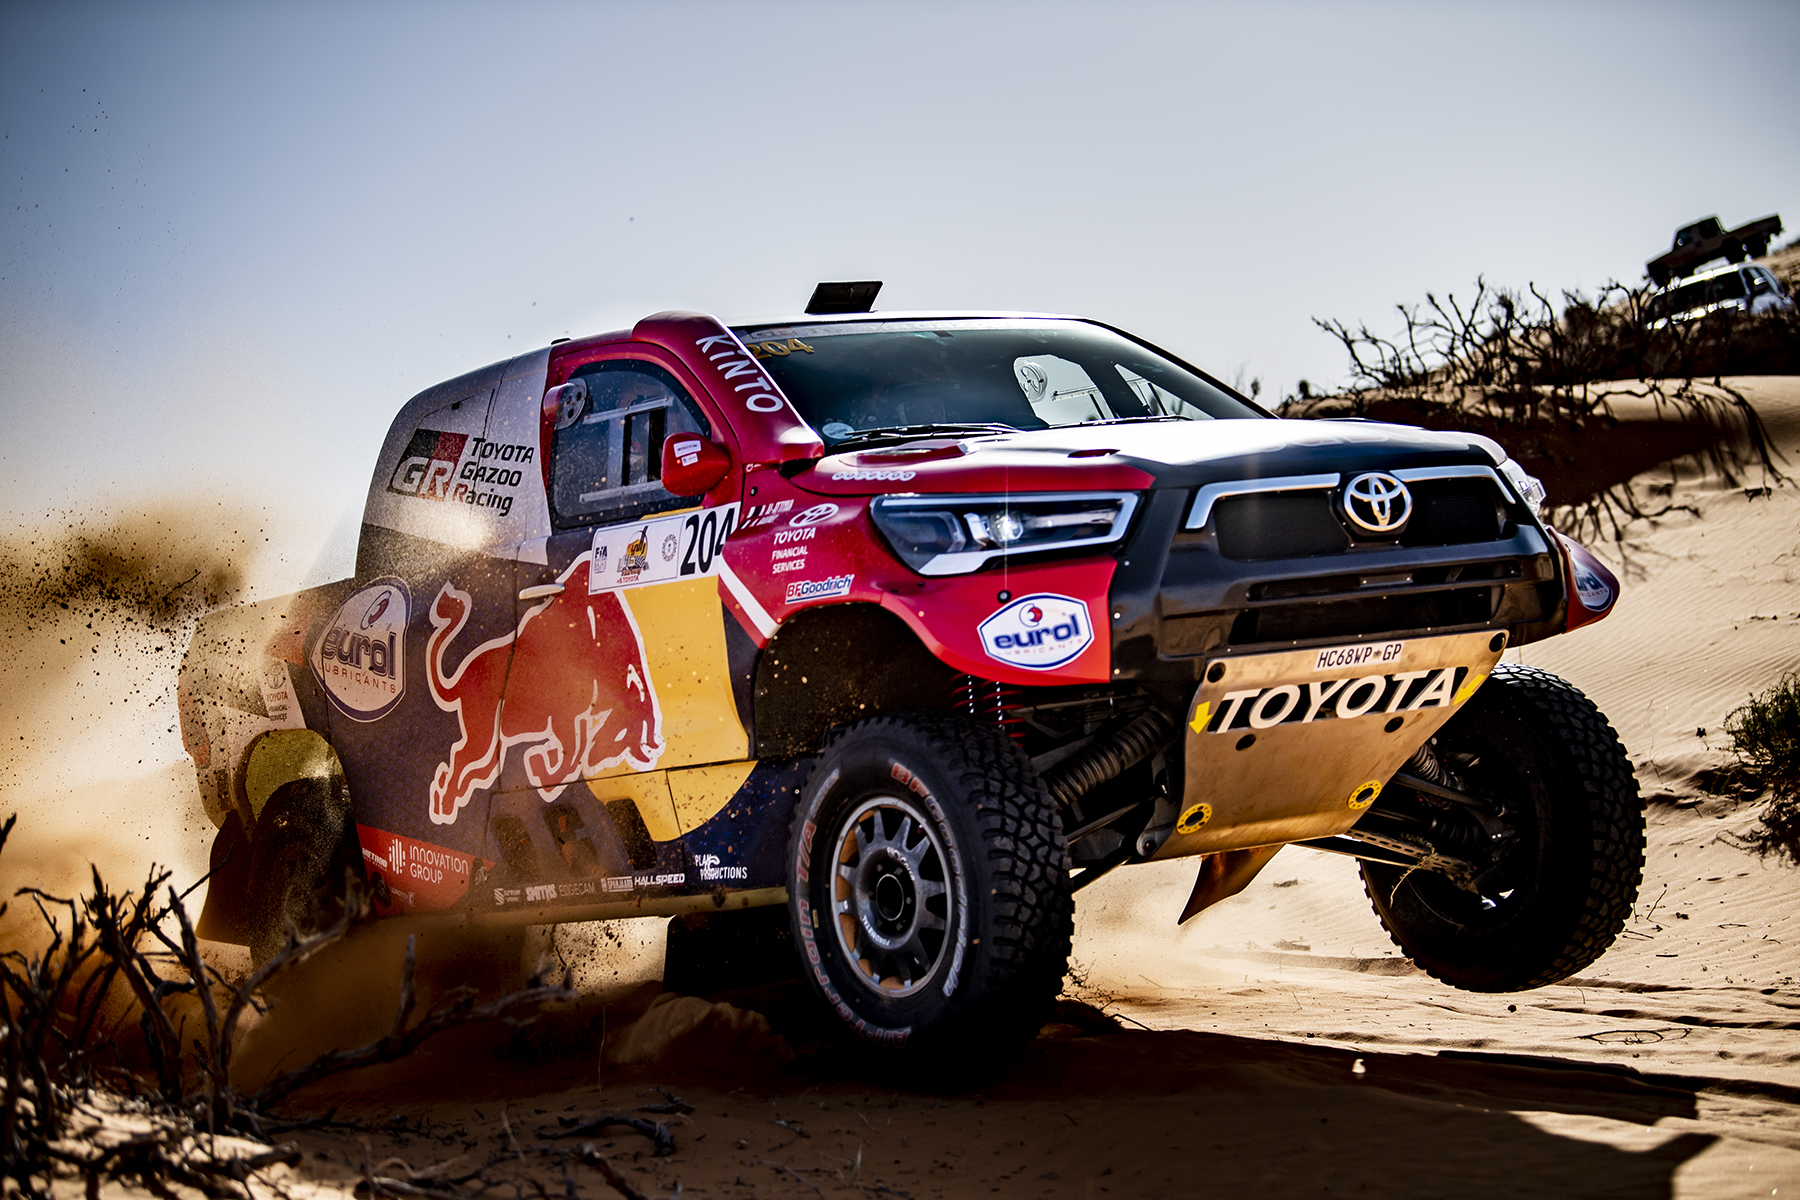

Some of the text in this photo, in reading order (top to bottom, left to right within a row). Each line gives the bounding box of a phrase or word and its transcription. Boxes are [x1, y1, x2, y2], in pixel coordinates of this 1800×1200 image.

[471, 437, 535, 464] TOYOTA
[391, 456, 456, 499] GR
[460, 461, 523, 487] GAZOO
[452, 482, 514, 517] Racing
[680, 507, 735, 576] 204
[773, 527, 816, 545] TOYOTA
[771, 545, 808, 560] FINANCIAL
[772, 558, 806, 574] SERVICES
[786, 576, 852, 598] BFGoodrich
[993, 612, 1081, 650] eurol
[322, 626, 397, 681] eurol
[1317, 643, 1402, 668] HC68WP GP
[317, 659, 397, 694] LUBRICANTS
[1216, 667, 1456, 734] TOYOTA
[409, 863, 443, 884] GROUP
[634, 873, 686, 887] HALLSPEED
[559, 882, 596, 897] EDGECAM
